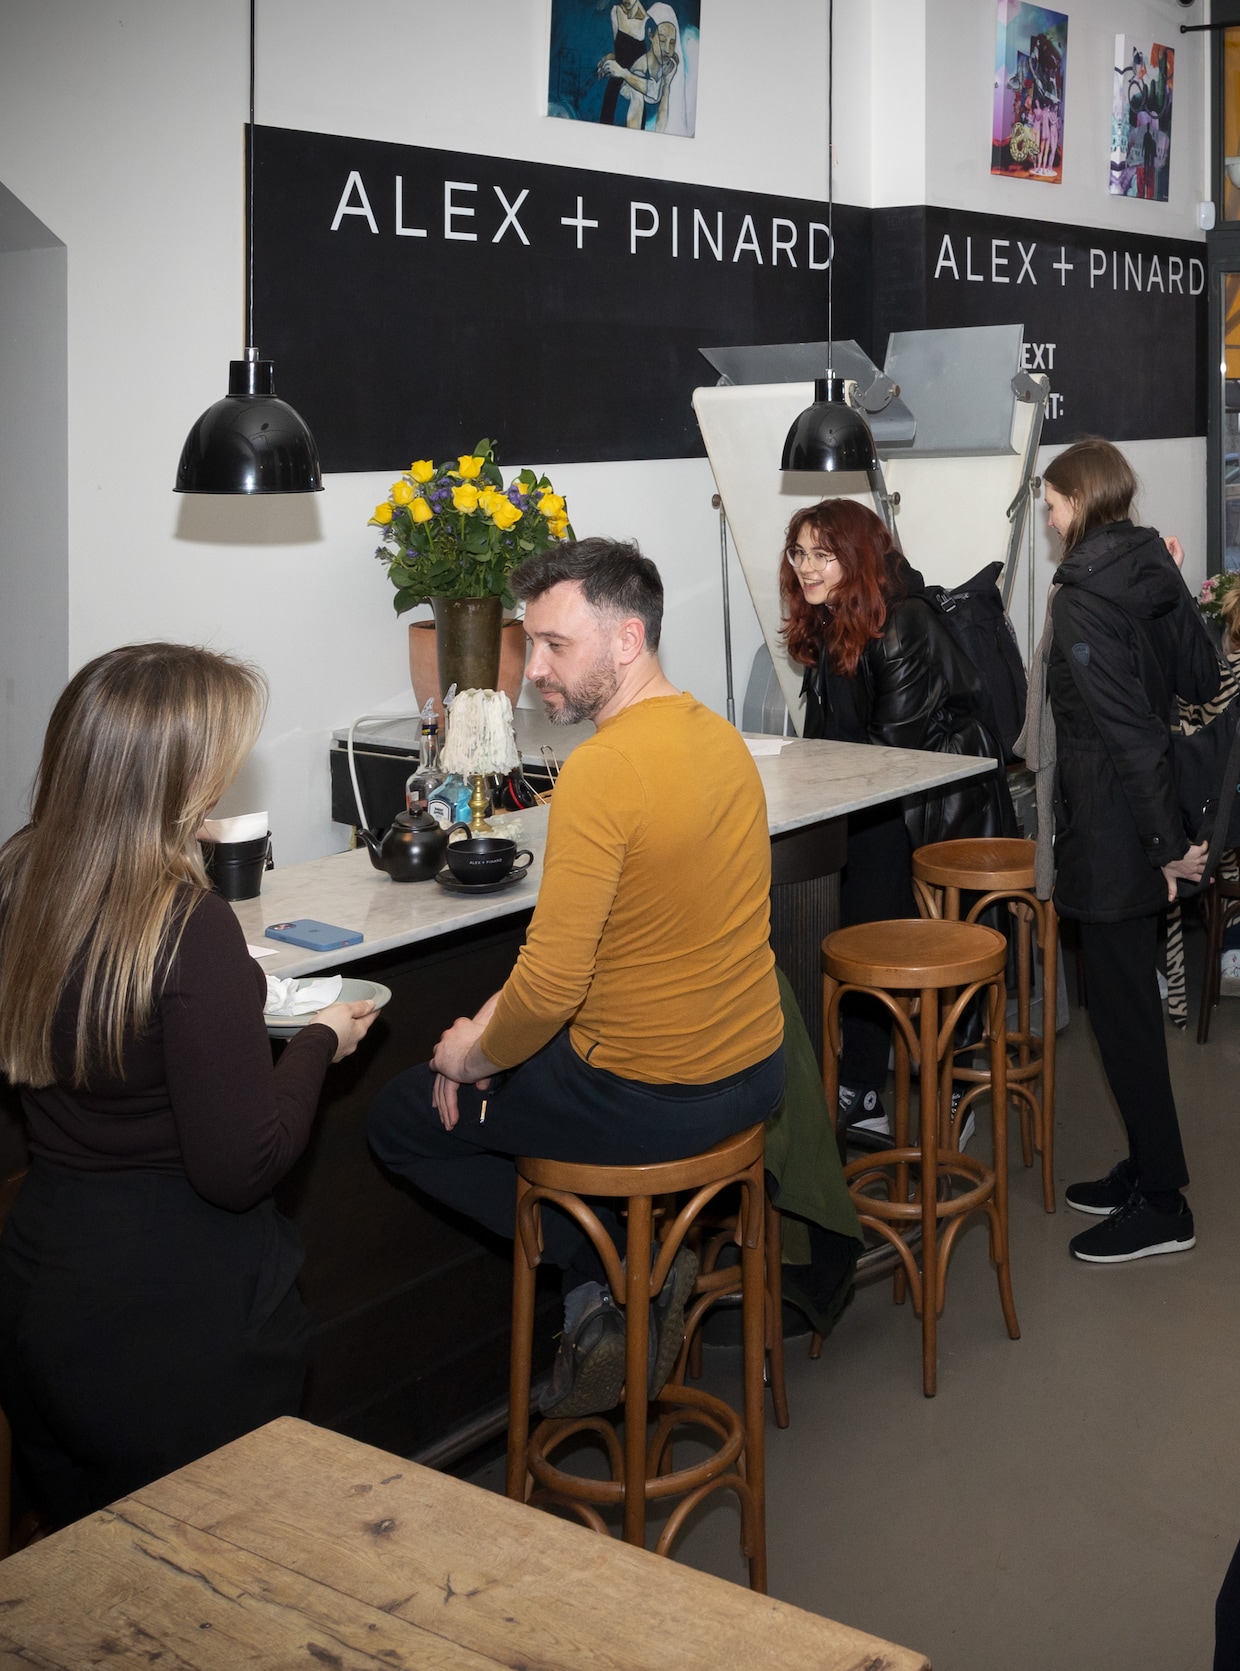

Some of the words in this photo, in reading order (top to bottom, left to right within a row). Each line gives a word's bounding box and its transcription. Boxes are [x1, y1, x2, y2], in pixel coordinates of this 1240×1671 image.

[330, 170, 531, 247] ALEX
[560, 195, 599, 249] +
[630, 201, 835, 271] PINARD
[934, 234, 1037, 286] ALEX
[1052, 246, 1074, 287] +
[1089, 248, 1205, 296] PINARD
[1021, 342, 1057, 370] EXT
